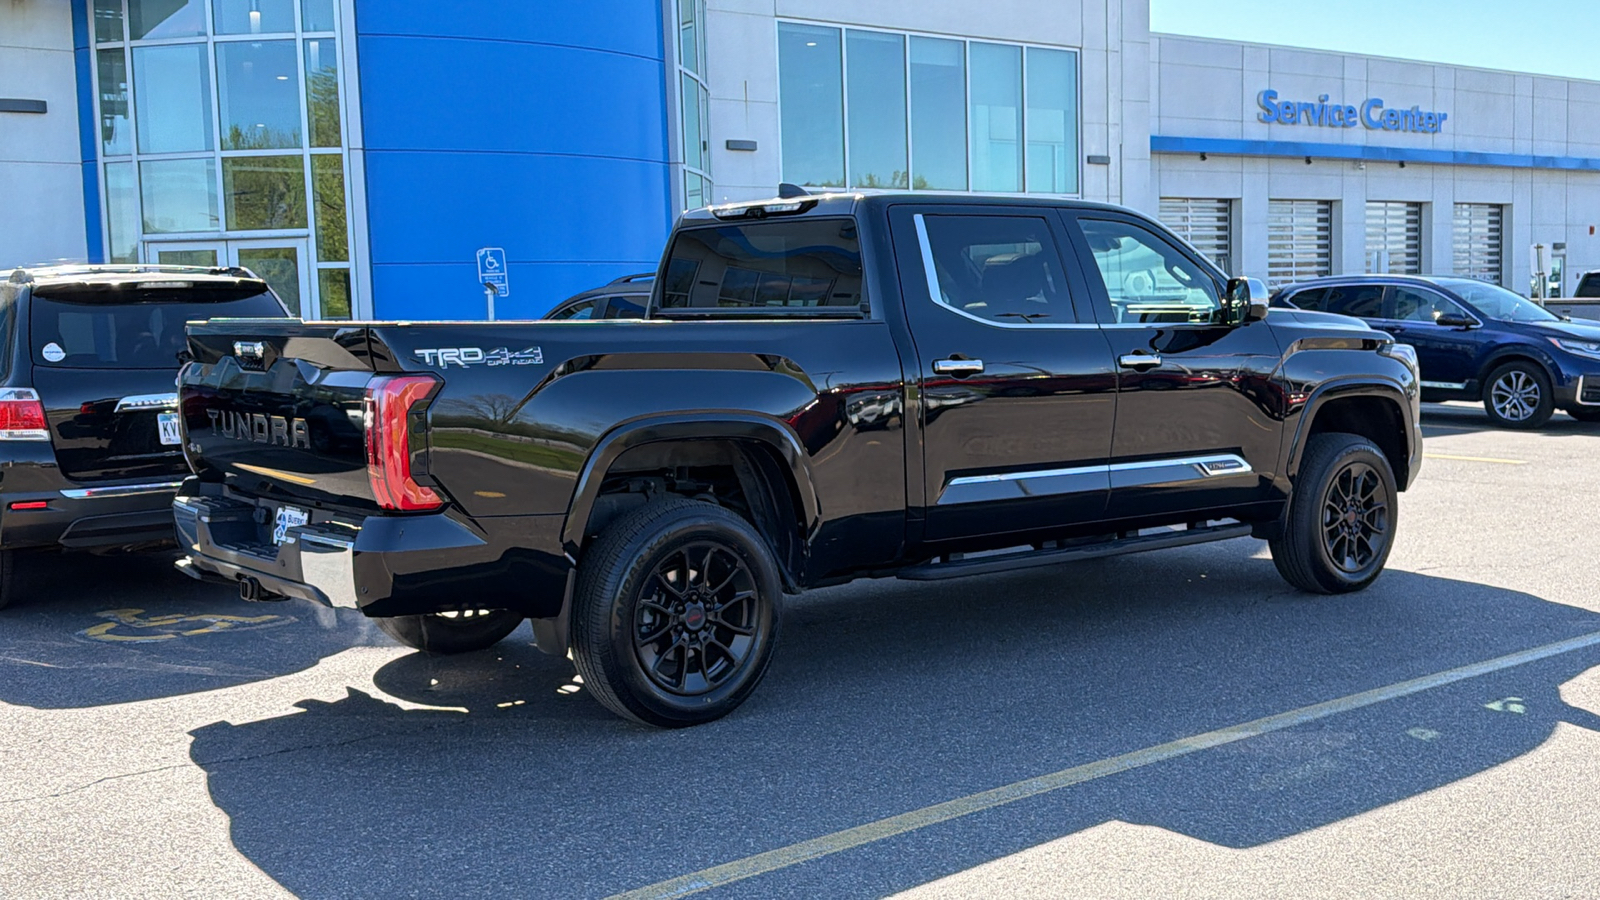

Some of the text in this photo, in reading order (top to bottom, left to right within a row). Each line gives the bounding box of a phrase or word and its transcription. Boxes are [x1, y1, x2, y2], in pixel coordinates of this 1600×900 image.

[1258, 89, 1448, 134] Service Center
[414, 347, 486, 369] TRD
[161, 421, 181, 438] KV
[206, 408, 312, 450] TUNDRA
